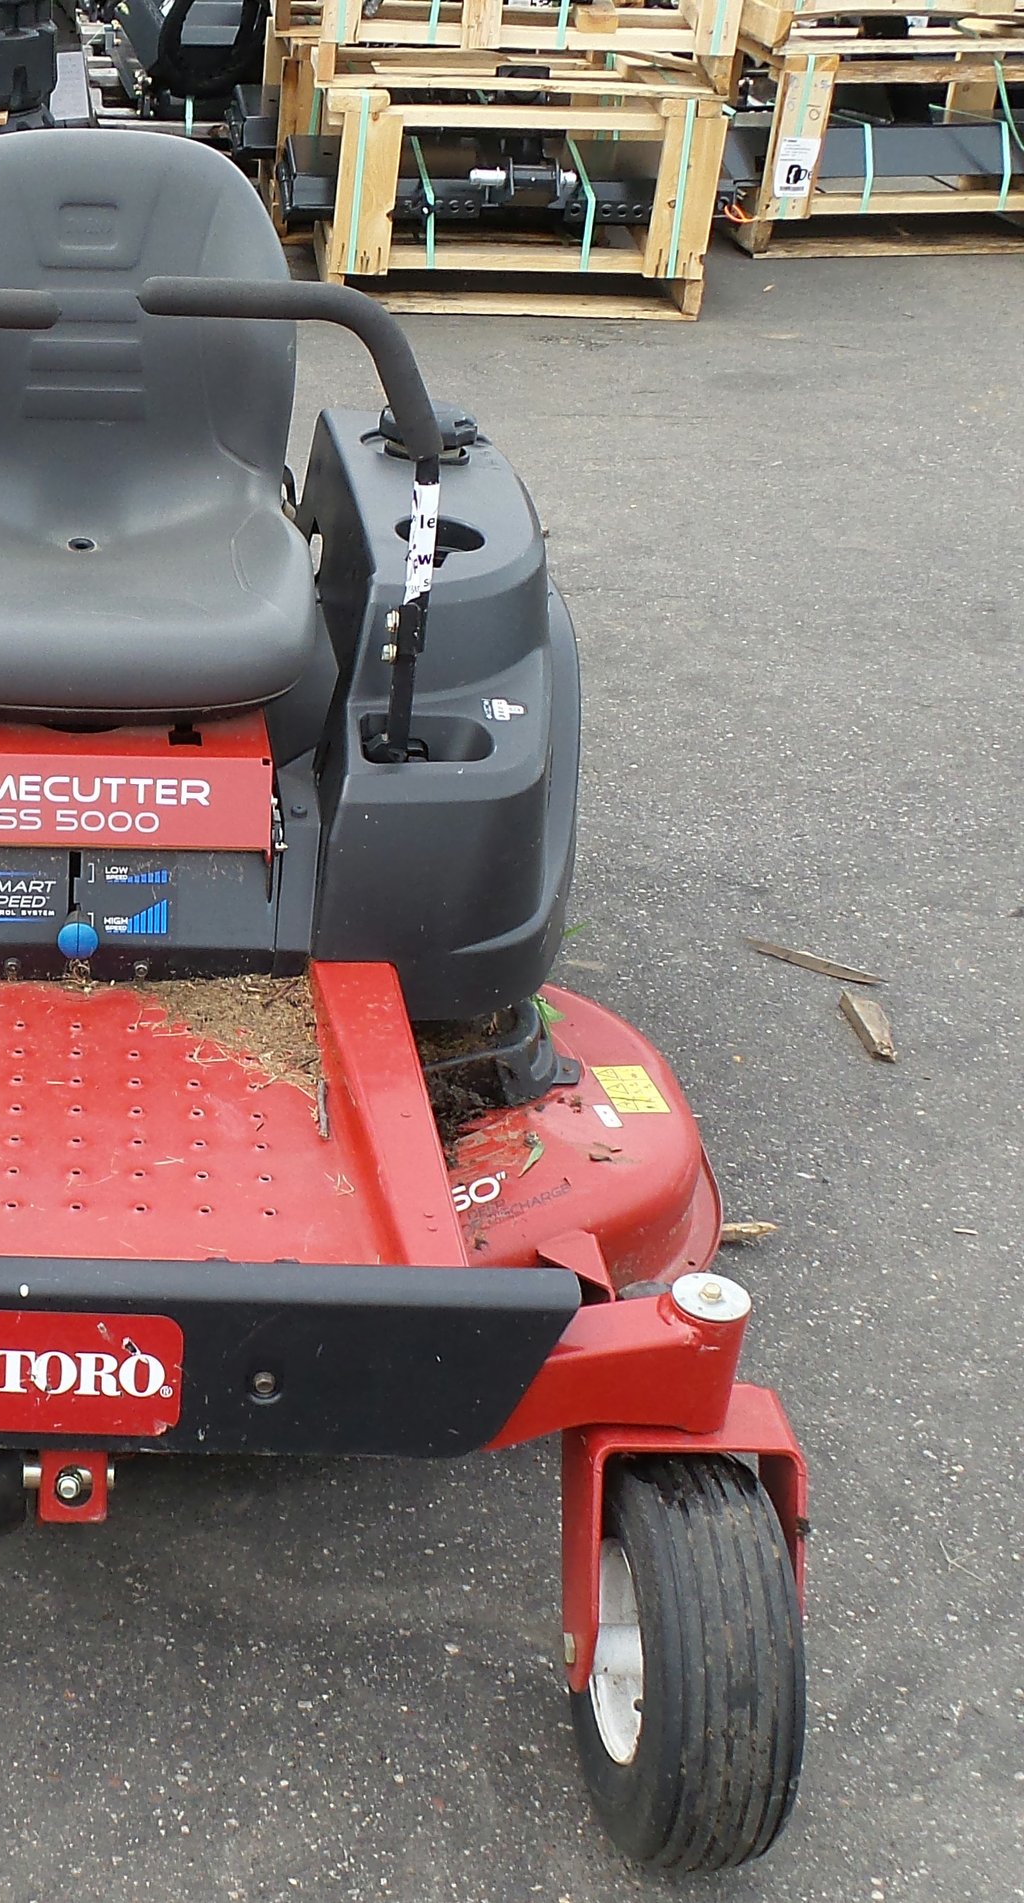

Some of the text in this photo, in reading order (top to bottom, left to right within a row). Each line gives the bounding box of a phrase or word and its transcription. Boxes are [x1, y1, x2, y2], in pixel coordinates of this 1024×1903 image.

[55, 809, 160, 833] 5000
[105, 866, 129, 874] LOW
[103, 916, 129, 925] HIGH
